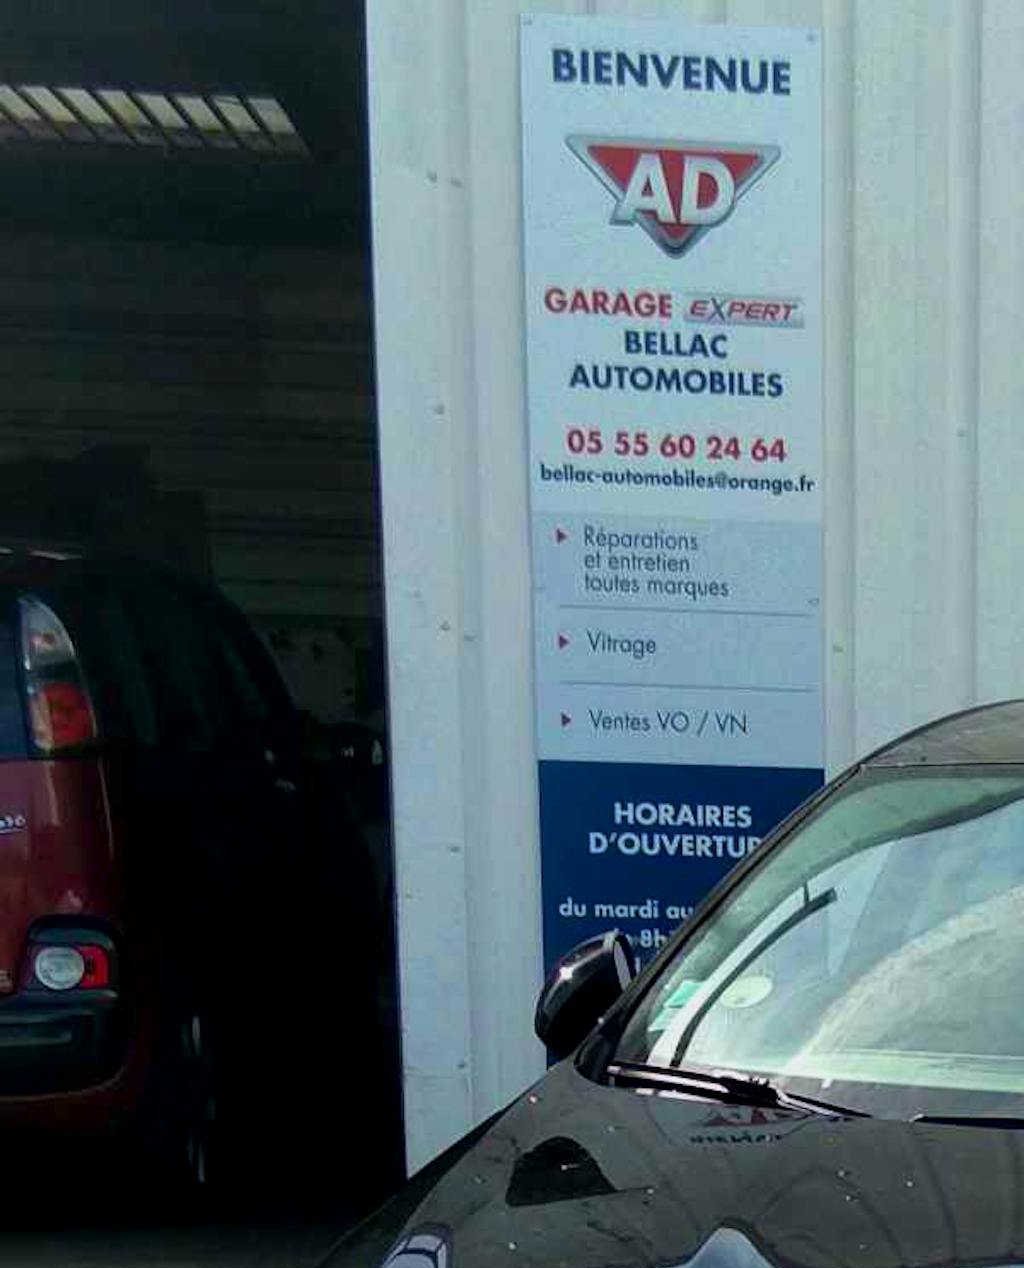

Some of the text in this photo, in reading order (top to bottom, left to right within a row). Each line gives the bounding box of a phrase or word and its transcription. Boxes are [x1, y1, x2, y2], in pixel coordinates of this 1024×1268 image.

[551, 48, 791, 96] BIENVENUE
[611, 151, 736, 225] AD
[544, 288, 672, 318] GARAGE
[624, 330, 728, 358] BELLAC
[569, 364, 783, 397] AUTOMOBILES
[567, 430, 787, 462] 05 55 60 24 64
[540, 463, 816, 495] bellac-automobiles@orange.fr
[584, 525, 698, 551] Réparations
[584, 552, 690, 572] et entretien
[585, 574, 729, 600] toutes marques
[587, 630, 656, 660] Vitrage
[589, 709, 748, 736] Ventes VO / VN
[614, 802, 752, 828] HORAIRES
[589, 832, 762, 859] D'OUVERTUR
[559, 897, 694, 920] du mardi au
